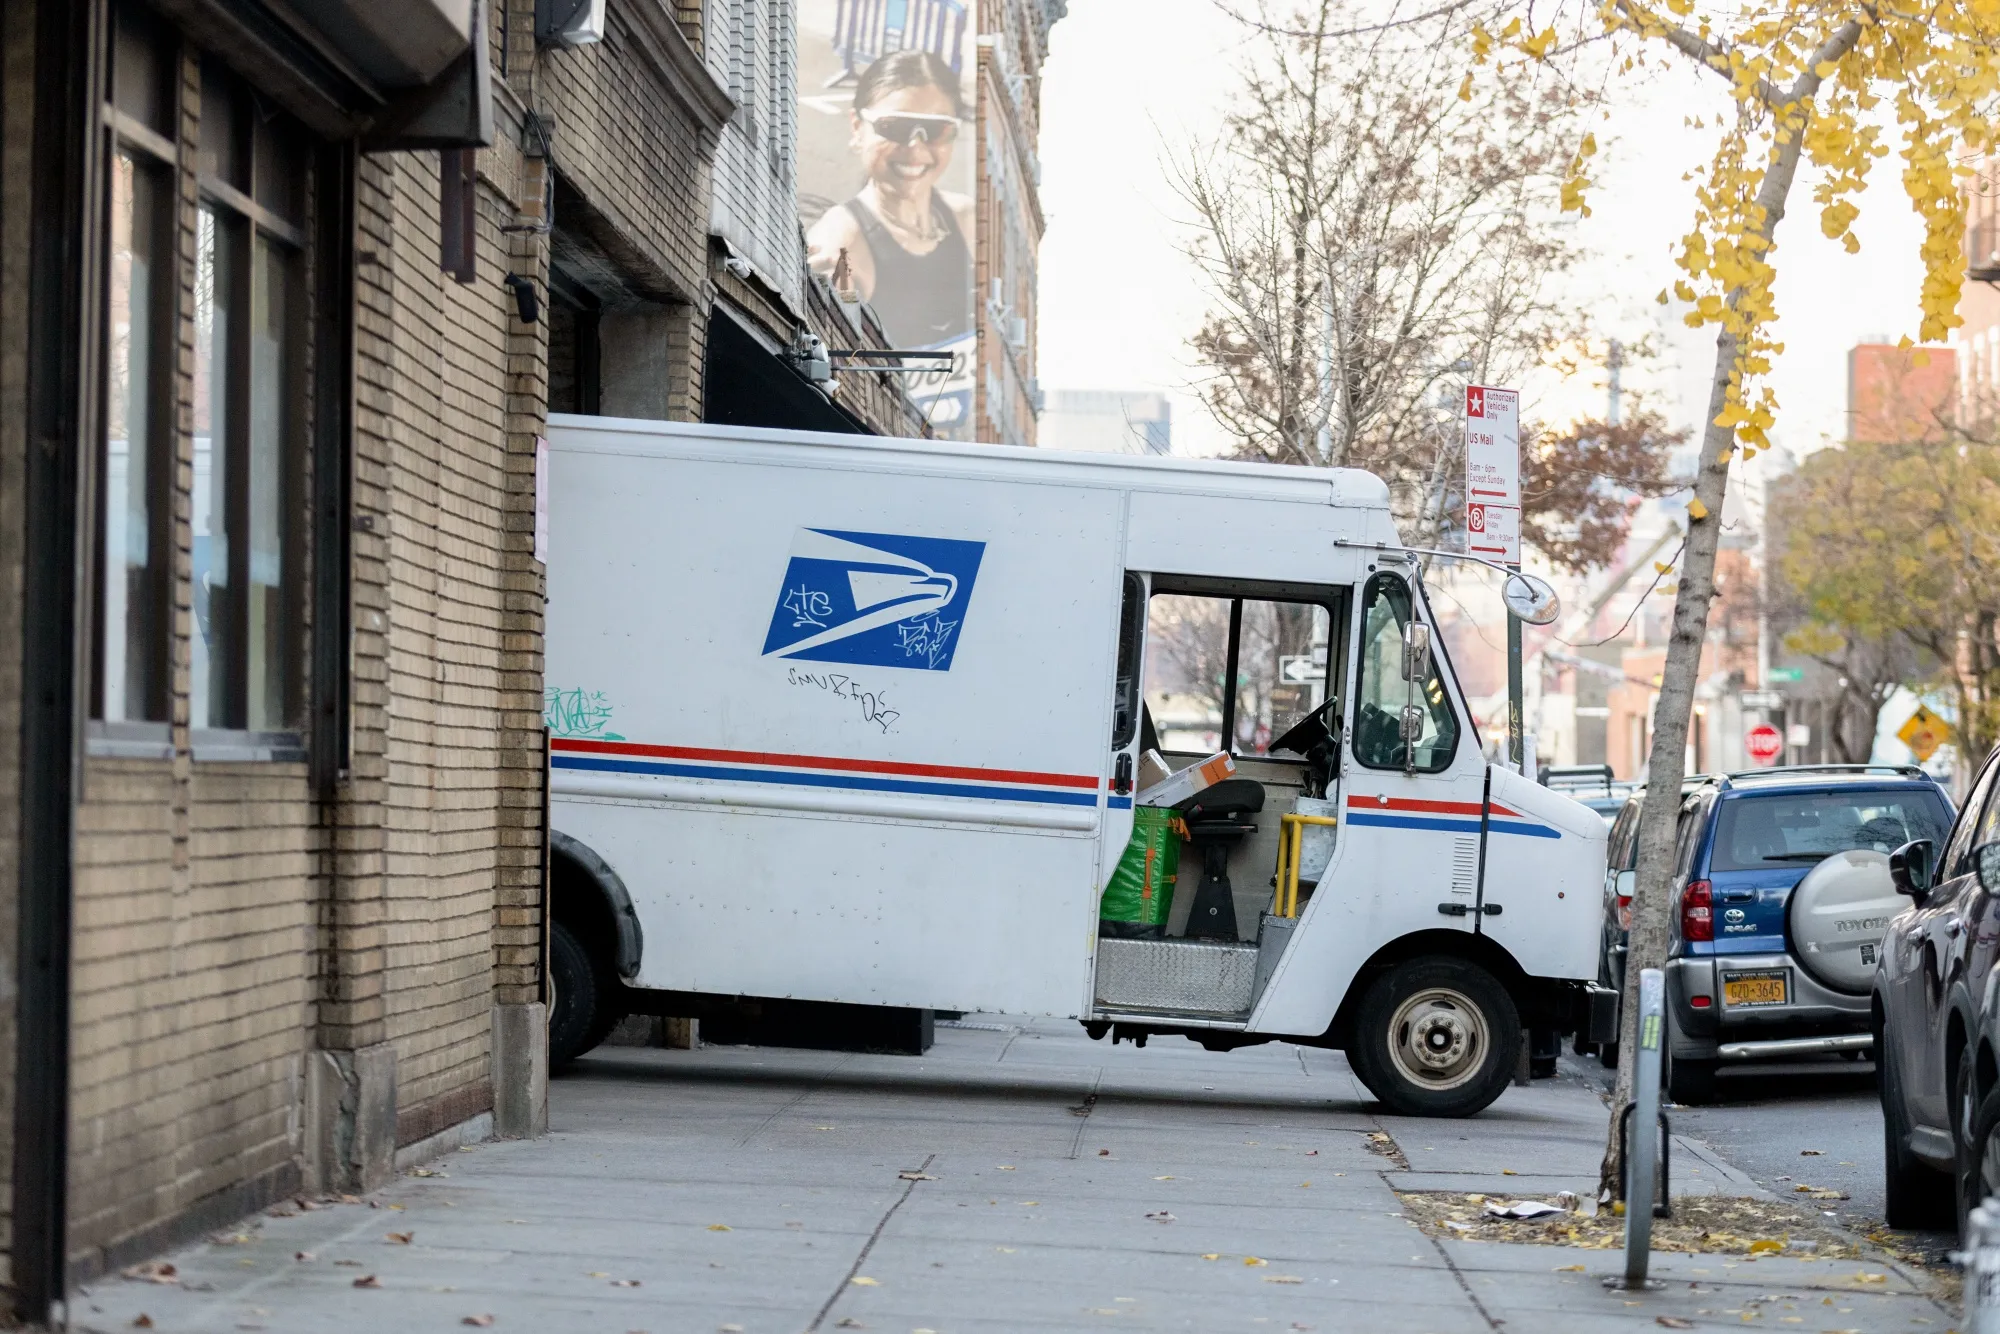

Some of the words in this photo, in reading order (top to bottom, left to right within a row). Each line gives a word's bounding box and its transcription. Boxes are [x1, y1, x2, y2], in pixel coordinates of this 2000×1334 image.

[1486, 391, 1515, 403] Authorized
[1486, 401, 1509, 412] Vehicles
[1486, 410, 1498, 421] Only
[1469, 432, 1478, 444] US
[1480, 433, 1494, 446] Mail
[1469, 462, 1480, 471] 8am
[1485, 464, 1497, 474] 6pm
[1469, 472, 1487, 484] Except
[1487, 475, 1506, 487] Sunday
[1486, 511, 1503, 520] Tuesday
[1486, 520, 1499, 529] Friday
[1834, 917, 1890, 932] TOYOTA
